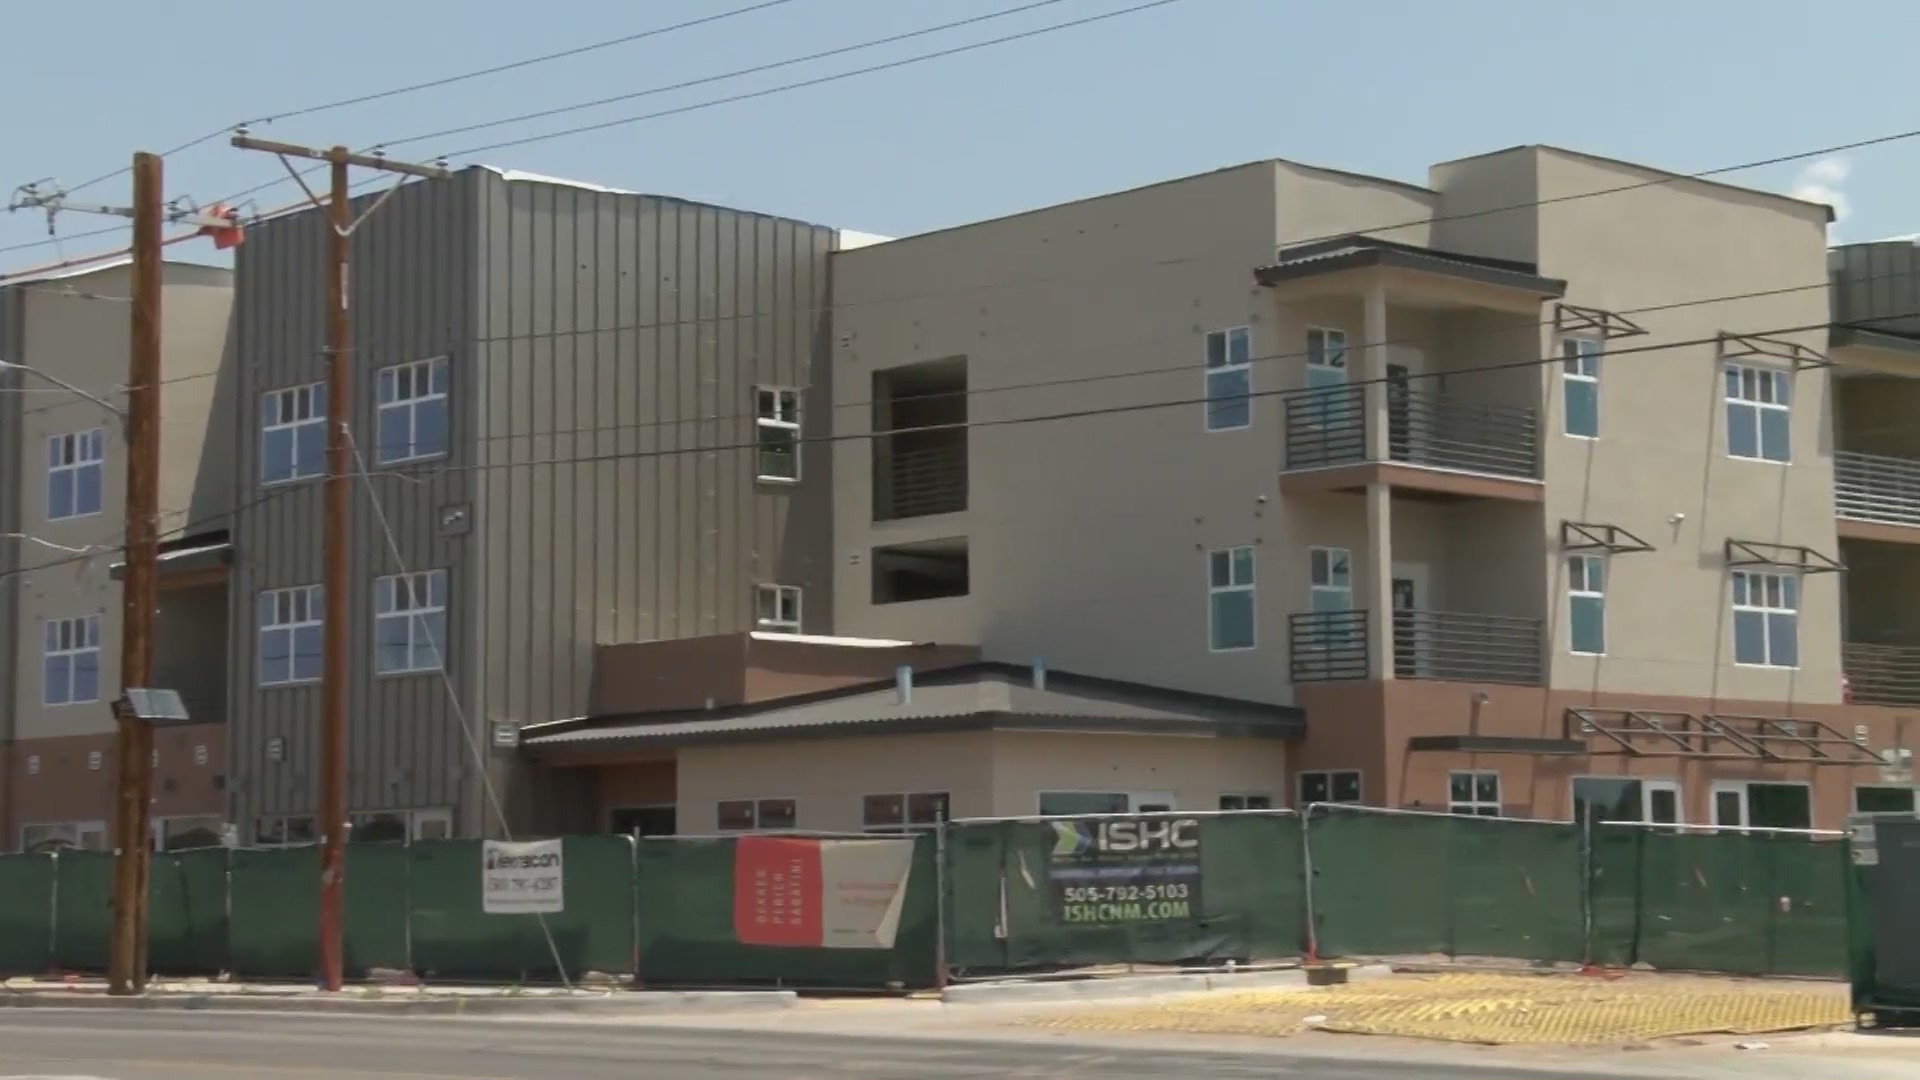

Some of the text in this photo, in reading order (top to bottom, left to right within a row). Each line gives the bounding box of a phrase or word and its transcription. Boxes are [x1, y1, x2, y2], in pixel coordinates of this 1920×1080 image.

[1098, 819, 1199, 850] ISHC
[1064, 883, 1189, 902] 505-792-5103
[1063, 901, 1190, 922] ISHCNM.COM
